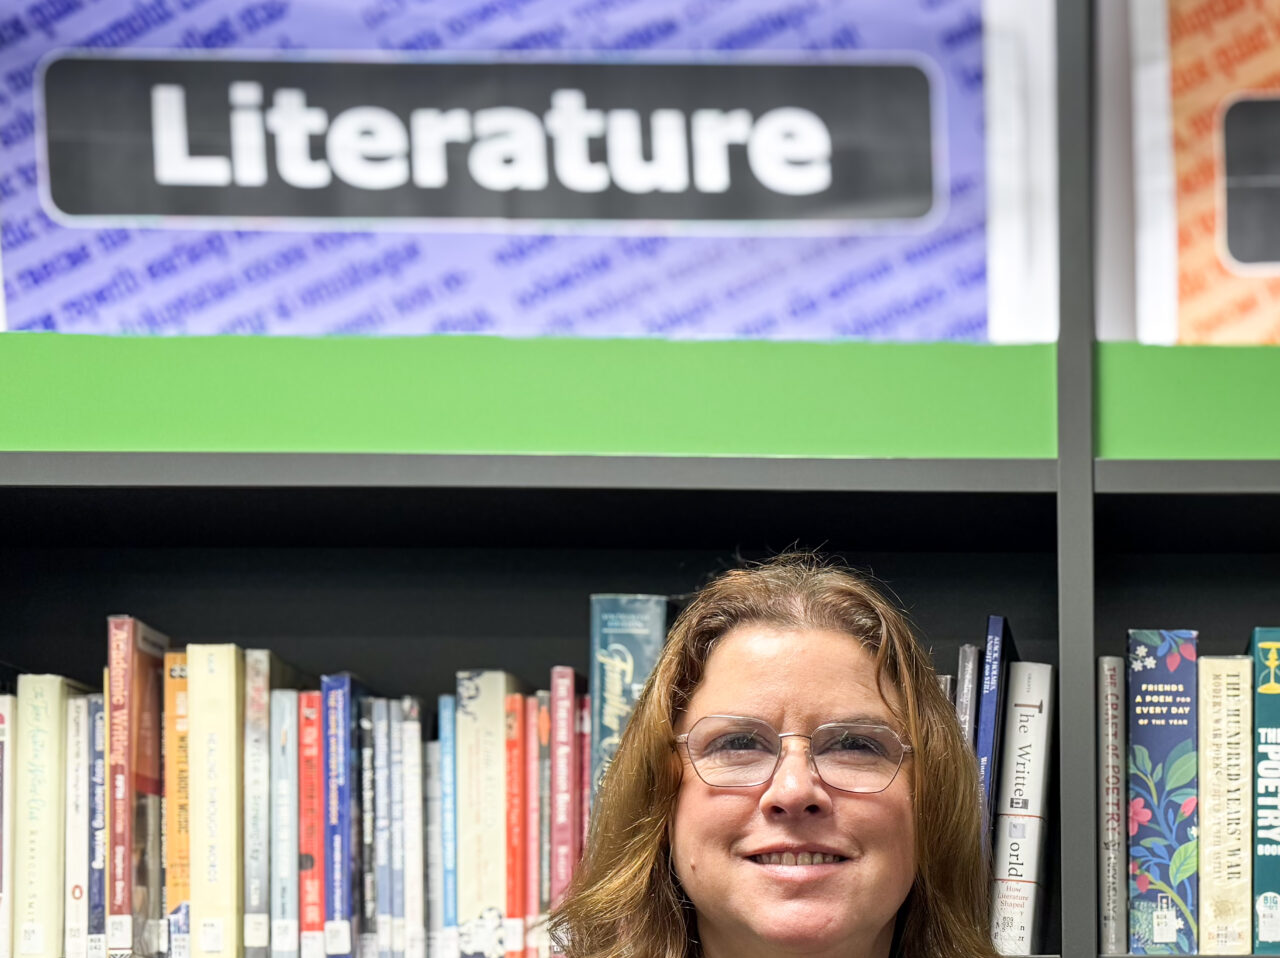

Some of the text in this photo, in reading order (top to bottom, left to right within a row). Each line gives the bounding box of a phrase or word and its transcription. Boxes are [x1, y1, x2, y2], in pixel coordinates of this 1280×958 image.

[150, 82, 832, 196] Literature
[111, 630, 128, 704] Academic
[1106, 666, 1118, 688] THE
[1135, 695, 1143, 703] A
[1145, 695, 1173, 703] POEM
[1141, 684, 1184, 692] FRIENDS
[109, 708, 127, 767] Writing
[1105, 693, 1120, 739] CRAFT
[1135, 706, 1190, 714] EVERY DAY
[1211, 673, 1223, 778] MODERN WAR POEMS
[1008, 699, 1043, 810] The Written
[1225, 672, 1242, 882] THE HUNDRED YEARS' WAR
[1104, 764, 1121, 838] POETRY
